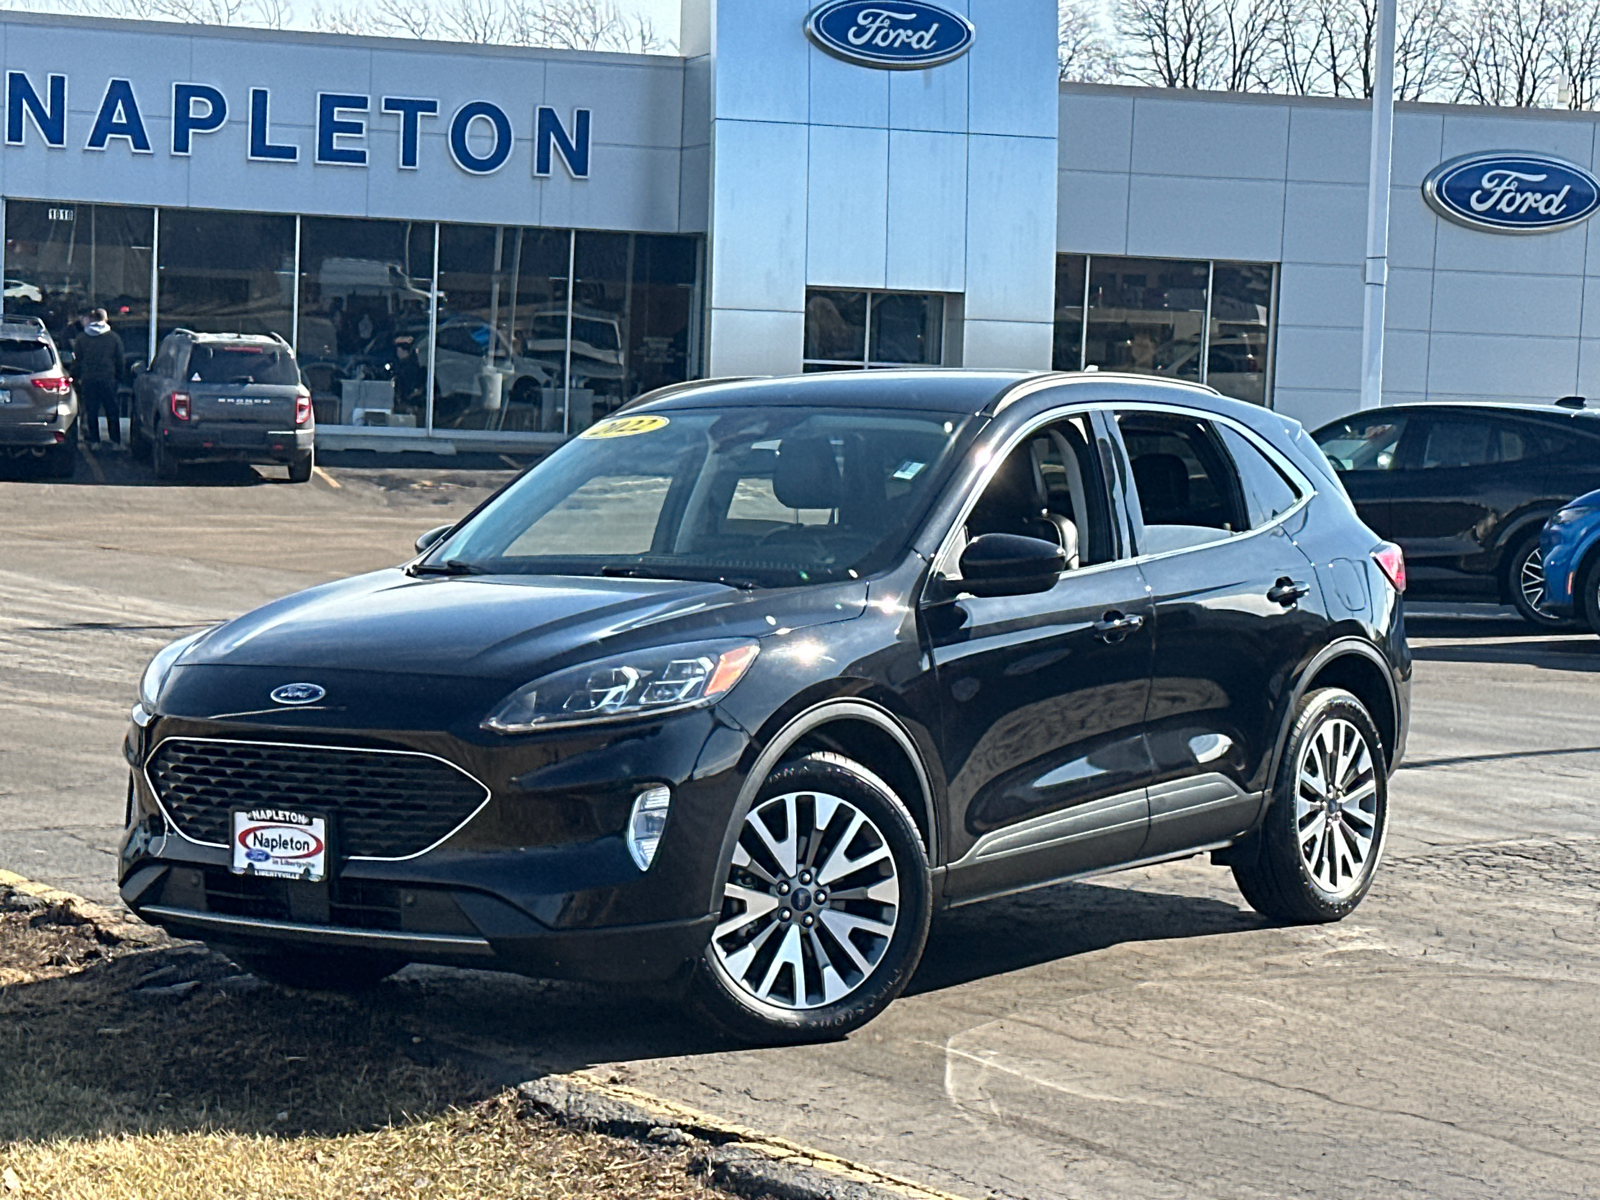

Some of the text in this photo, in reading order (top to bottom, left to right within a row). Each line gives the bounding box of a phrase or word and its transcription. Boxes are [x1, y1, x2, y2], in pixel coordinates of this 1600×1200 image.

[847, 8, 940, 50] Ford
[4, 70, 592, 179] NAPLETON
[1469, 169, 1571, 216] Ford
[588, 419, 658, 436] 2022
[251, 809, 307, 825] NAPLETON
[252, 831, 311, 853] Napleton
